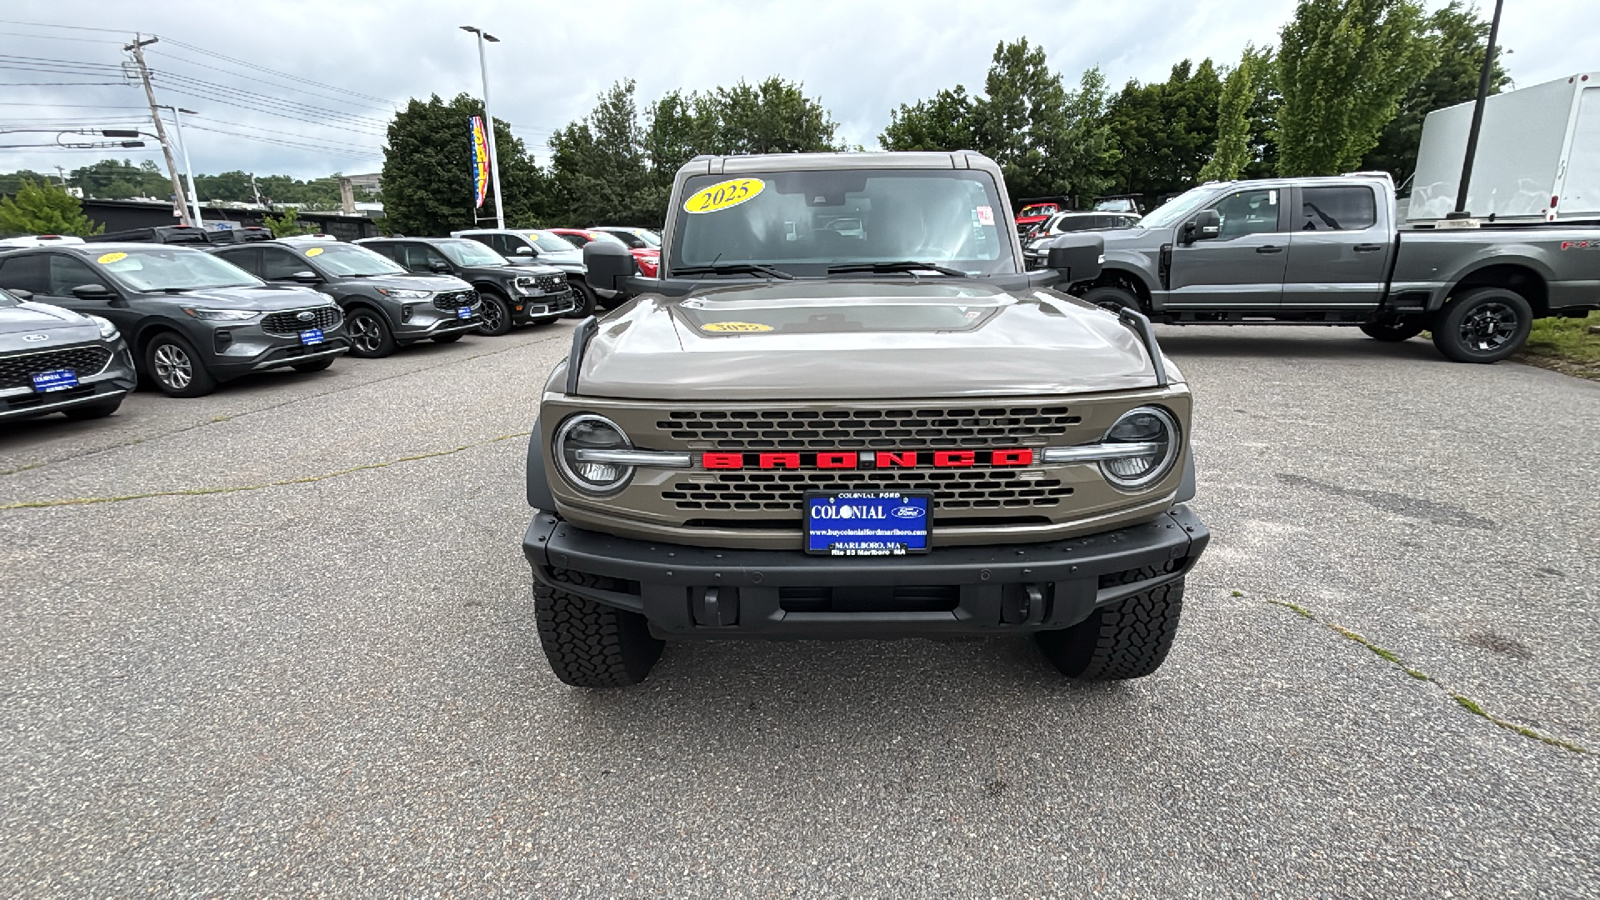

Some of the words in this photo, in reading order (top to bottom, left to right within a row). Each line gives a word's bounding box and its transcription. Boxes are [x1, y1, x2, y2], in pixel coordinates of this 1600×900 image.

[699, 181, 750, 210] 2025
[702, 448, 1034, 469] BRONCO
[811, 505, 887, 519] COLONIAL
